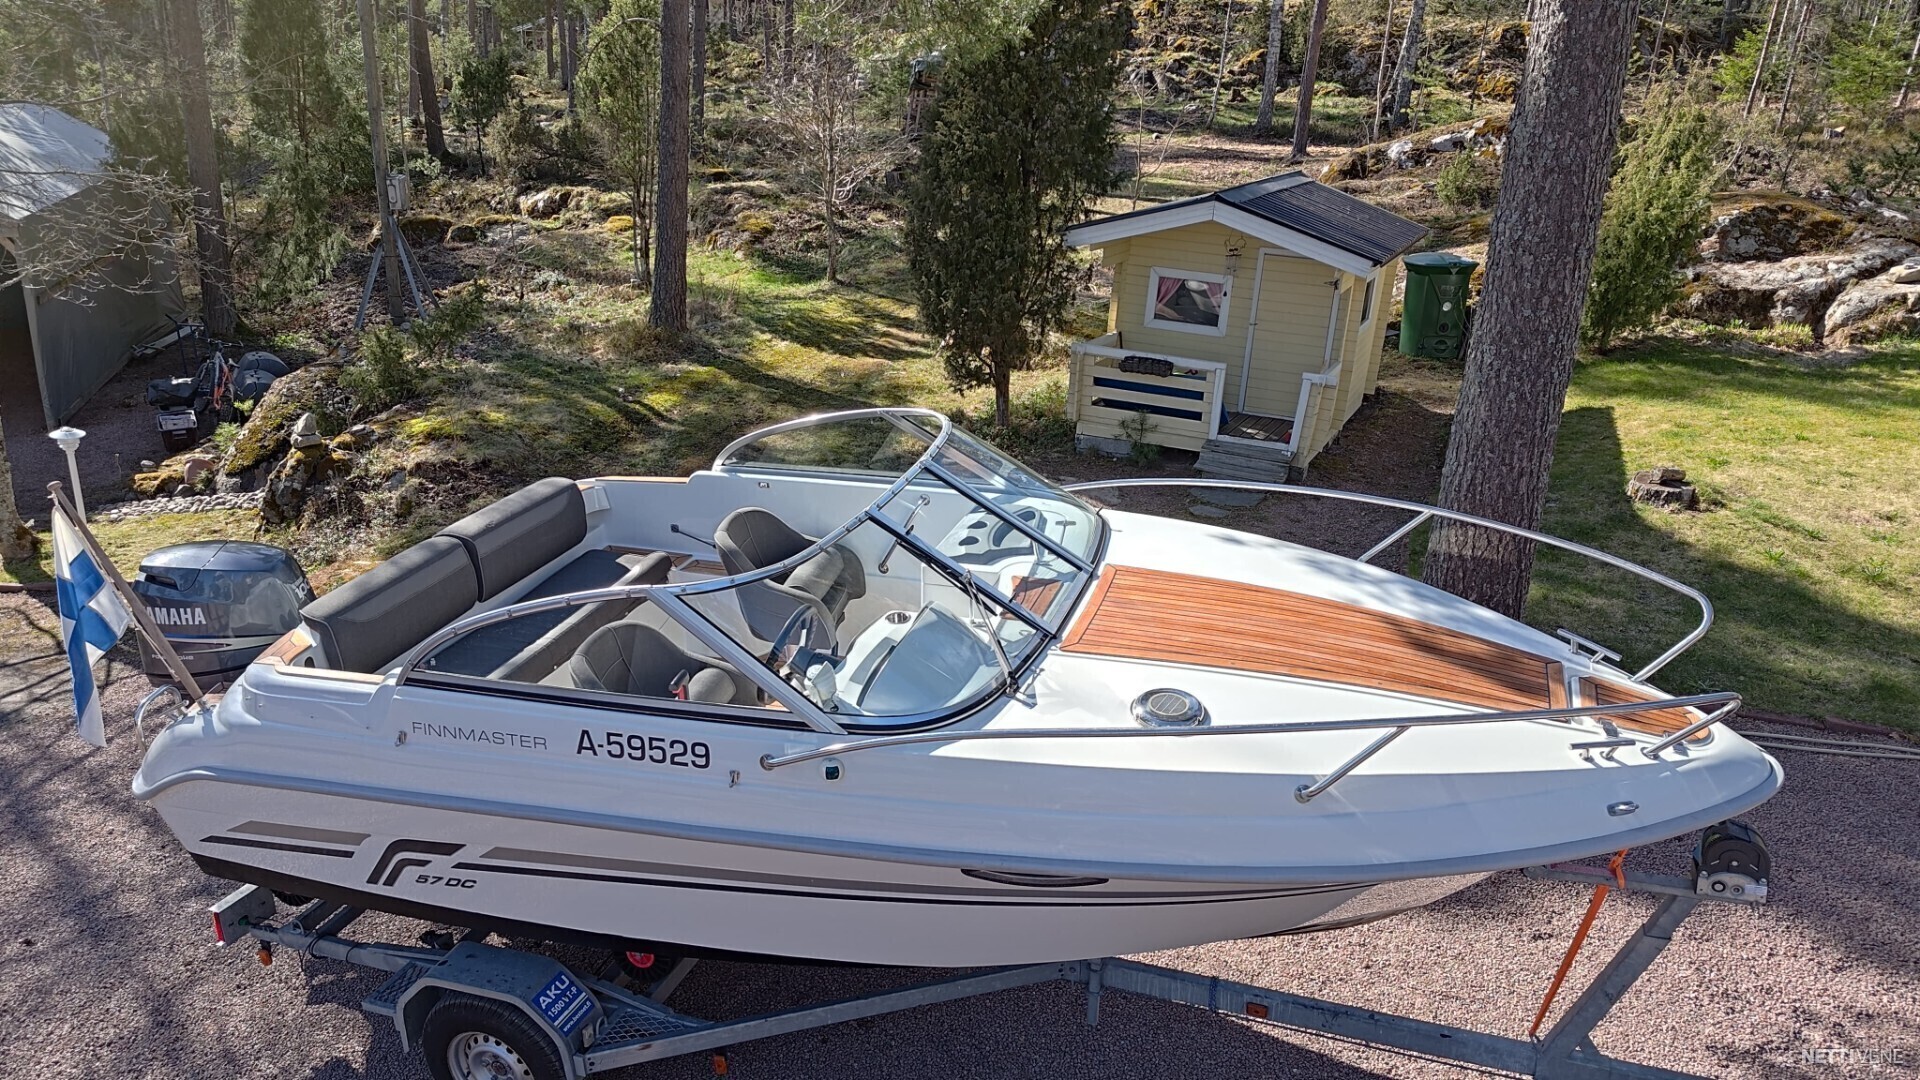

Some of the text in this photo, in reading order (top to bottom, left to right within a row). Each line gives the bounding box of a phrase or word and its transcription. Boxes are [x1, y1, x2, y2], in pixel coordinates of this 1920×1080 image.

[146, 606, 207, 625] AMAHA
[412, 721, 548, 750] FINNMASTER
[576, 729, 711, 769] A-59529
[415, 874, 478, 889] 57 DC
[539, 975, 570, 1010] AKU
[547, 1000, 565, 1017] 1500
